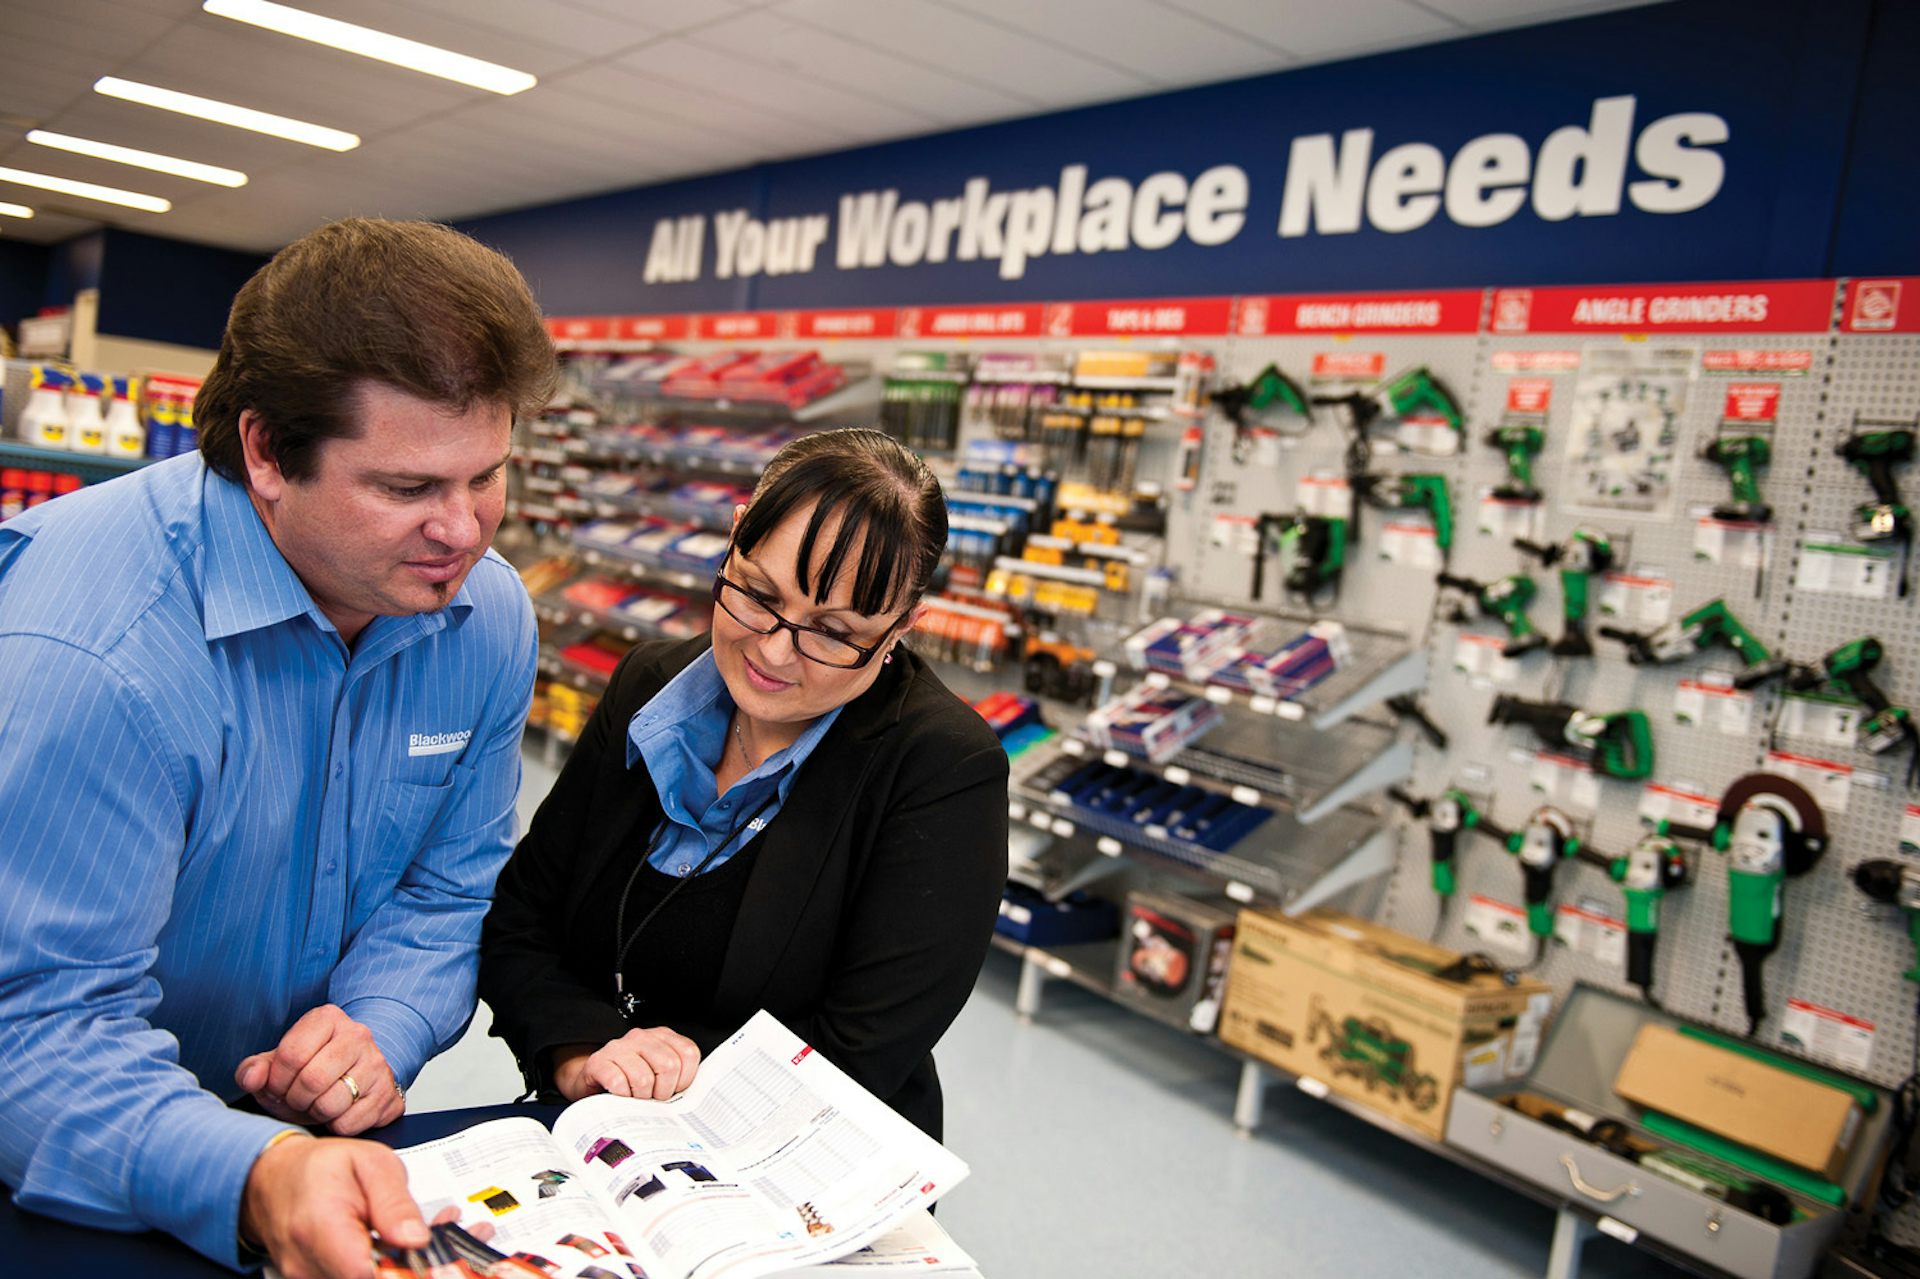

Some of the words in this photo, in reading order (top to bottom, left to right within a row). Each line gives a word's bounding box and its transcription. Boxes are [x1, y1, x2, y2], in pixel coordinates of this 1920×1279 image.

[643, 218, 705, 283] All
[714, 210, 828, 278] Your
[835, 164, 1249, 279] Workplace
[1278, 95, 1729, 238] Needs
[1351, 301, 1441, 327] GRINDERS
[1572, 298, 1646, 324] ANGLE
[1649, 295, 1769, 323] GRINDERS
[409, 729, 472, 746] Blackwoo
